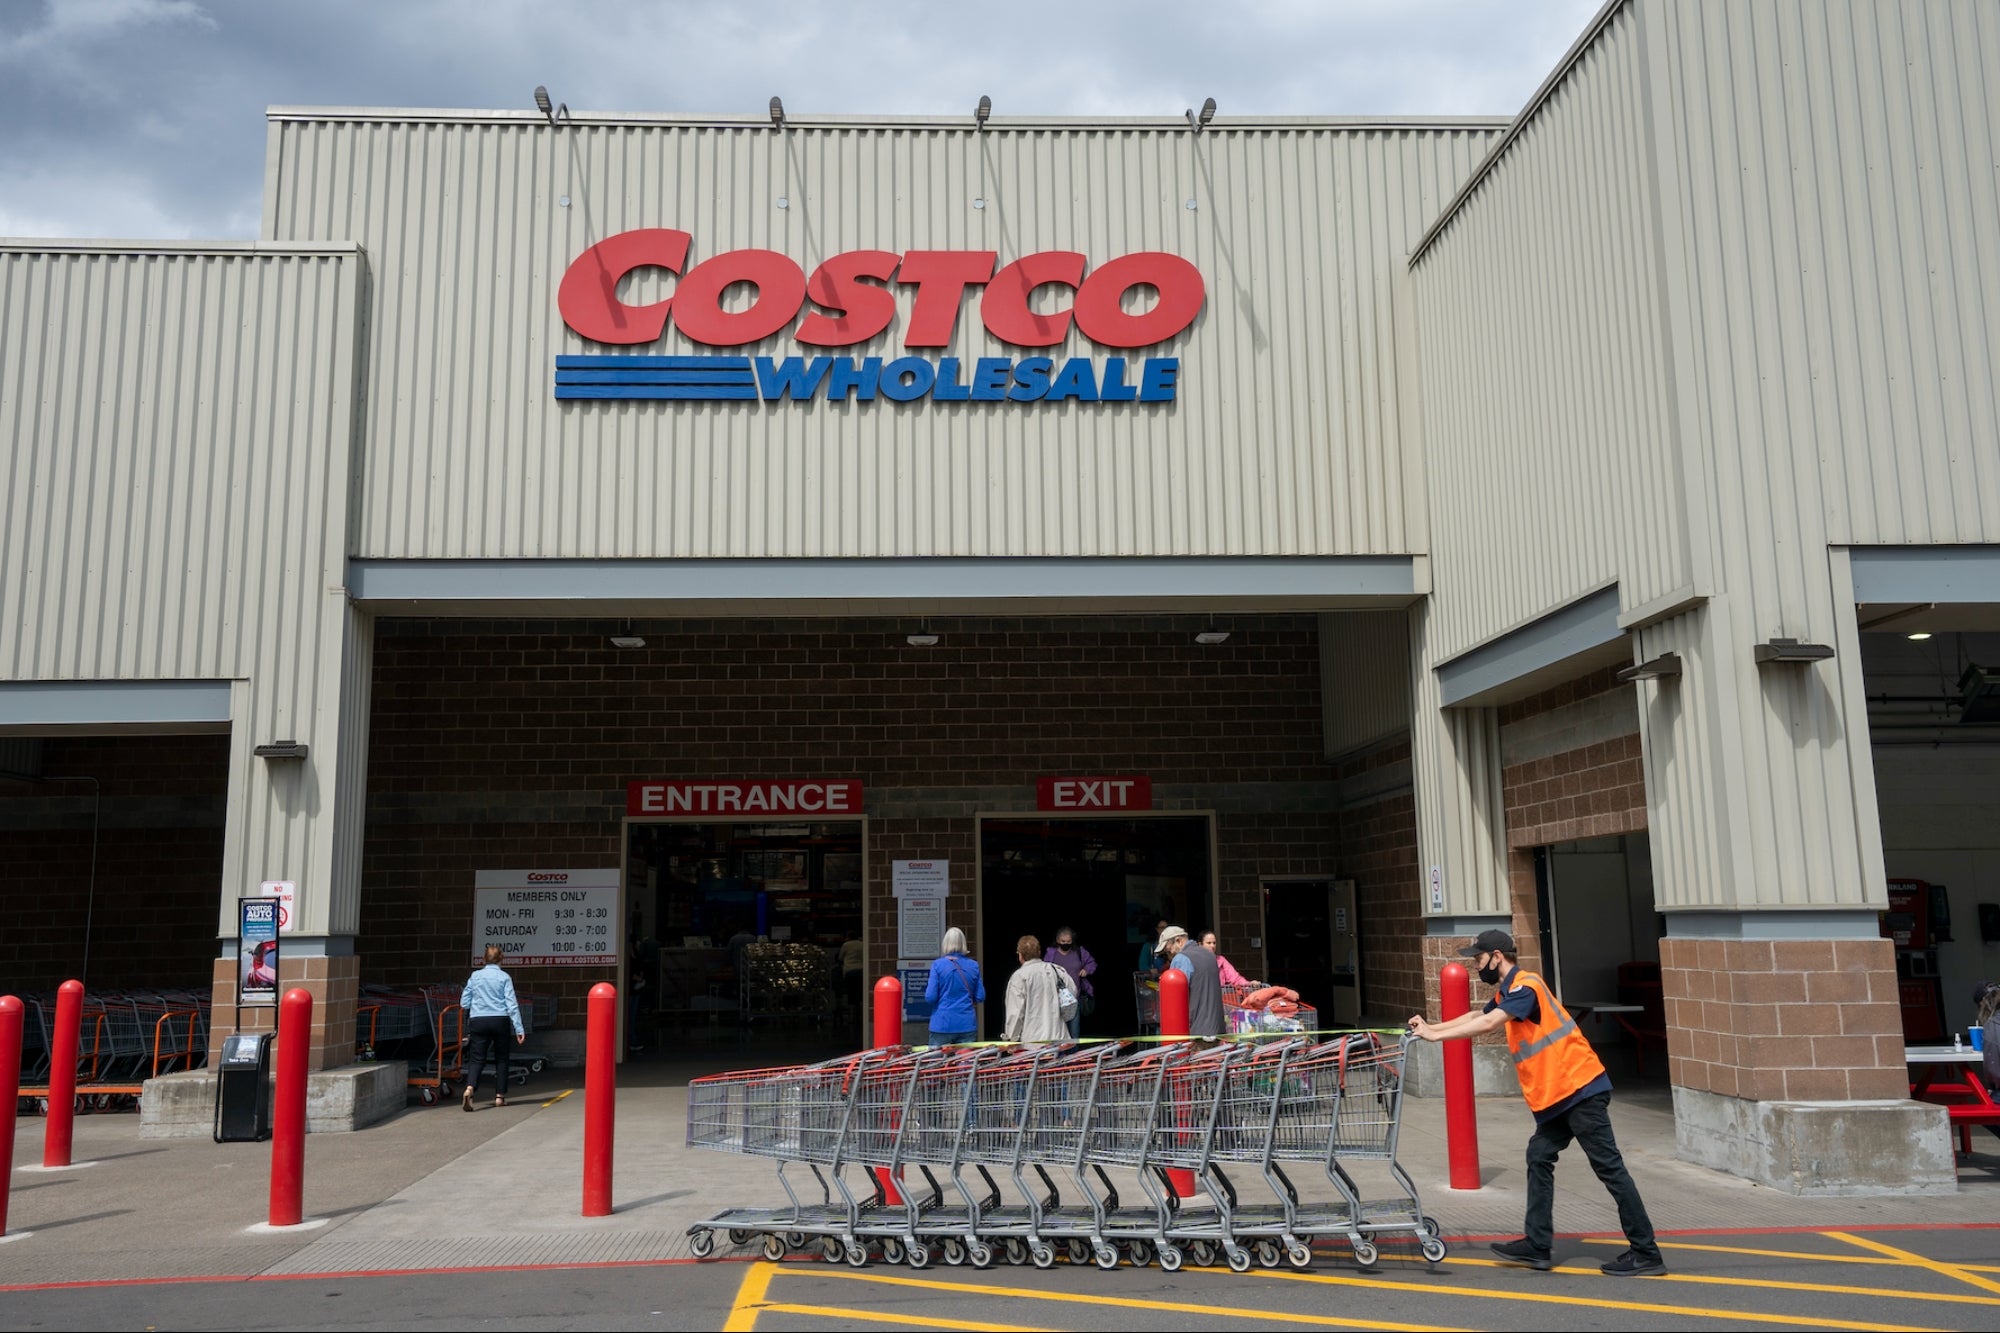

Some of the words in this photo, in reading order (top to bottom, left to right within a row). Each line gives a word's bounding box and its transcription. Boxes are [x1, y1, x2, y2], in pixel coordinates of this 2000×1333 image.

[557, 228, 1206, 347] COSTCO
[753, 356, 1180, 401] WHOLESALE
[641, 783, 849, 811] ENTRANCE
[1053, 780, 1134, 807] EXIT
[527, 872, 568, 881] COSTCO
[507, 891, 558, 902] MEMBERS
[560, 891, 587, 901] ONLY
[246, 910, 273, 918] AUTO
[486, 908, 509, 919] MON
[518, 908, 534, 918] FRI
[554, 909, 575, 918] 9:30
[586, 908, 607, 918] 8:30
[485, 925, 538, 936] SATURDAY
[555, 925, 577, 935] 9:30
[586, 925, 607, 935] 7:00
[551, 942, 575, 952] 10:00
[584, 942, 606, 952] 6:00
[555, 956, 616, 964] WWW.COSTCO.COM
